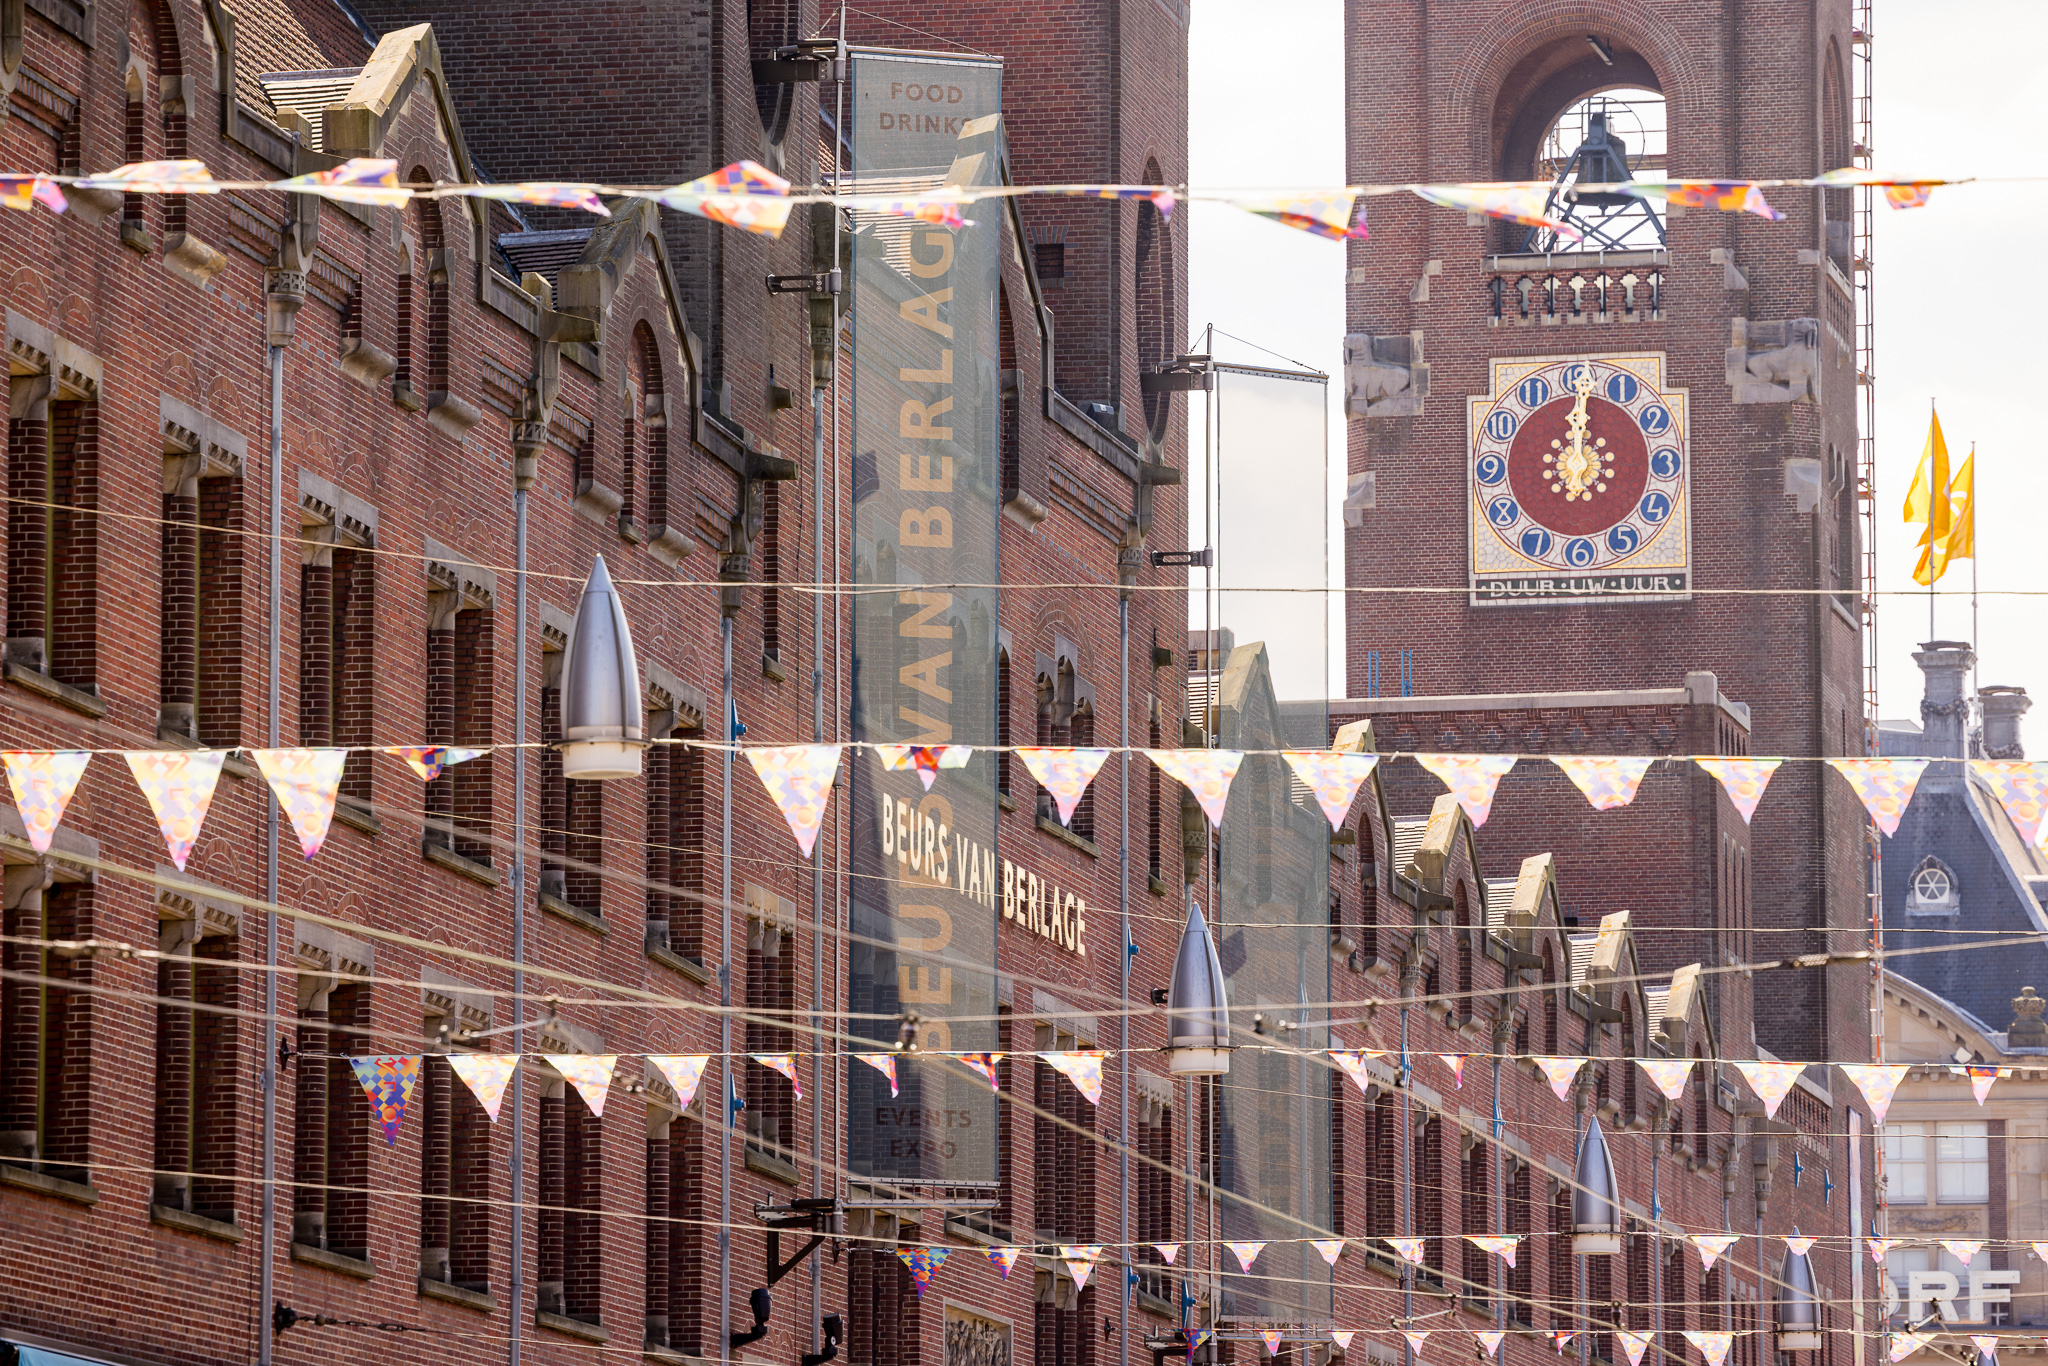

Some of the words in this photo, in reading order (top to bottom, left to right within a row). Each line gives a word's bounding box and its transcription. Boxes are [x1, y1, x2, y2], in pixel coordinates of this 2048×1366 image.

[891, 82, 963, 104] FOOD
[879, 112, 974, 136] DRINKS
[899, 182, 956, 548] BERLAG
[1524, 378, 1544, 406] 11
[1617, 375, 1627, 402] 1
[1490, 412, 1511, 440] 10
[1646, 406, 1663, 433] 2
[1481, 455, 1498, 481] 9
[1657, 449, 1675, 478] 3
[1495, 498, 1513, 526] 8
[1646, 494, 1664, 521] 4
[1527, 528, 1544, 556] 7
[1571, 539, 1590, 566] 6
[1615, 526, 1632, 553] 5
[1490, 579, 1557, 598] DUUR
[899, 590, 954, 745] VAN
[882, 792, 949, 886] BEURS
[955, 832, 996, 912] VAN
[1003, 858, 1087, 957] BERLAGE
[875, 1107, 972, 1129] EVENTS
[890, 1139, 958, 1160] EXPO
